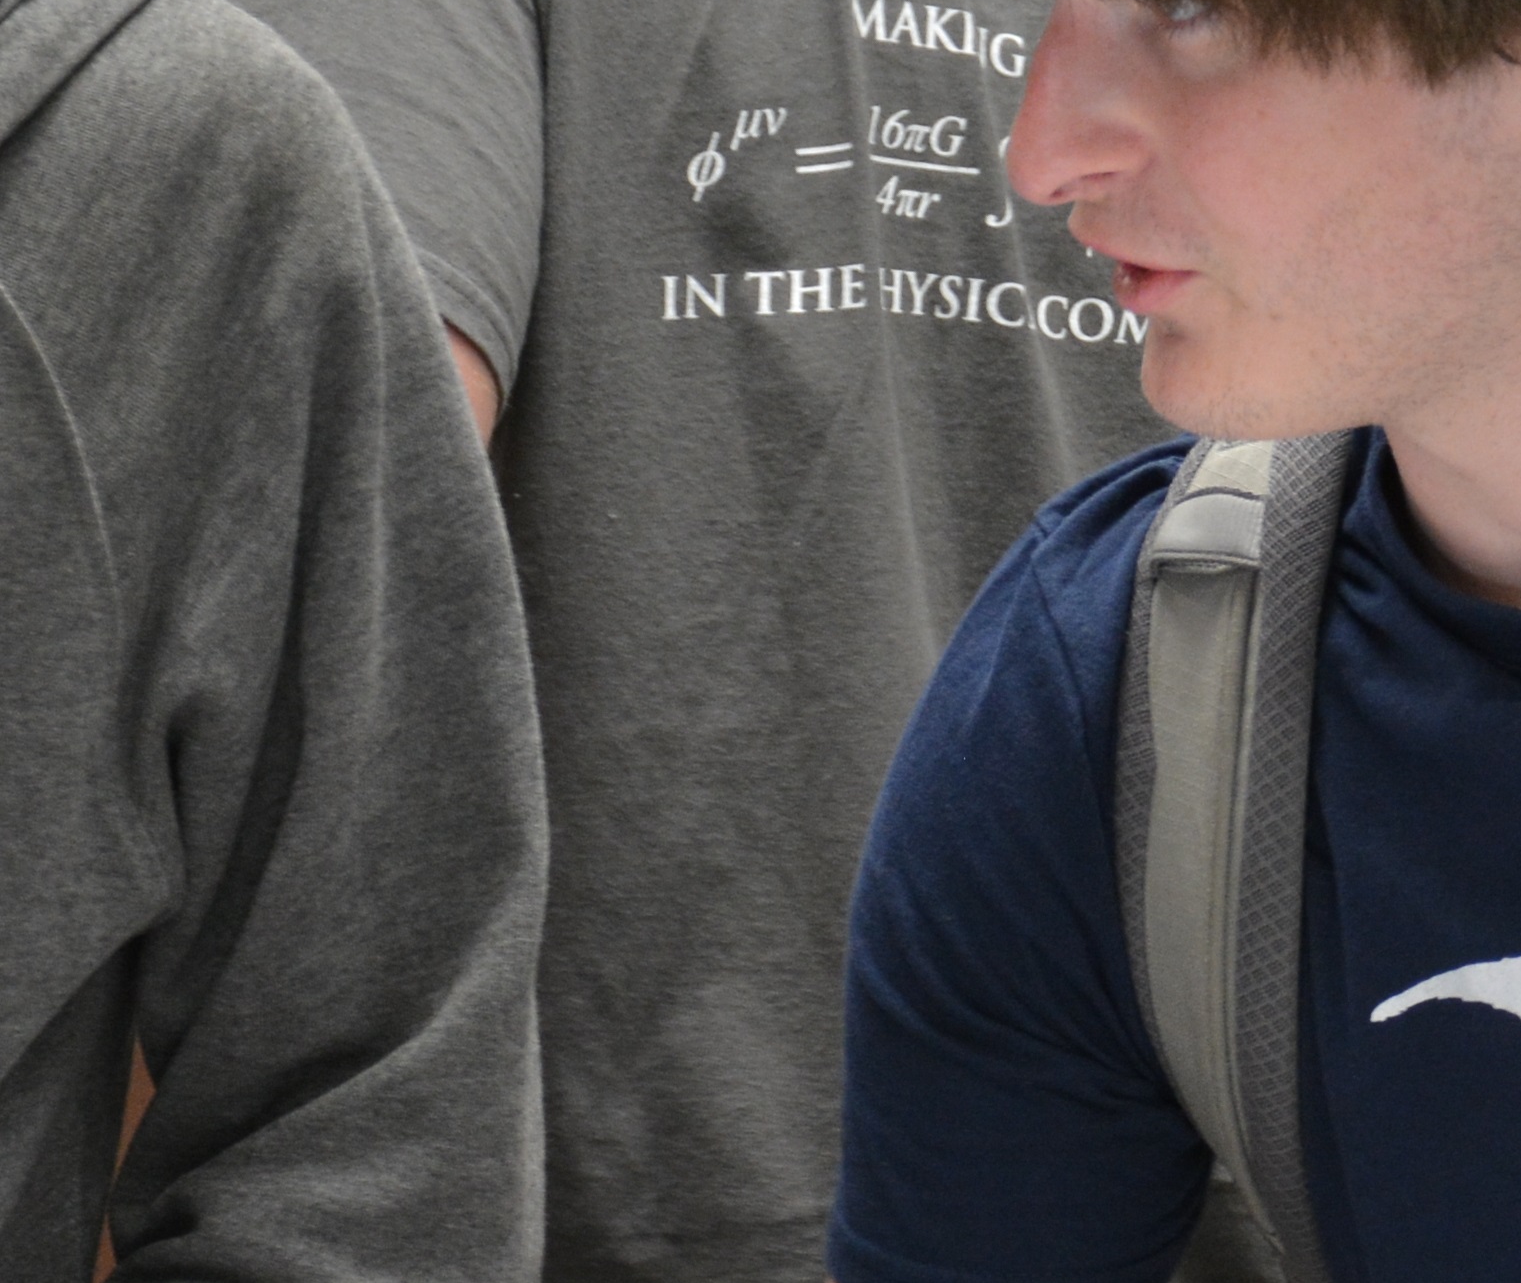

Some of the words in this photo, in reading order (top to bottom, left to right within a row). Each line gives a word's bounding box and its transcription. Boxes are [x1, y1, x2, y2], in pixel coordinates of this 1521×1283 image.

[660, 272, 728, 320] IN
[743, 263, 868, 316] THE
[879, 267, 1036, 330] HYSIC
